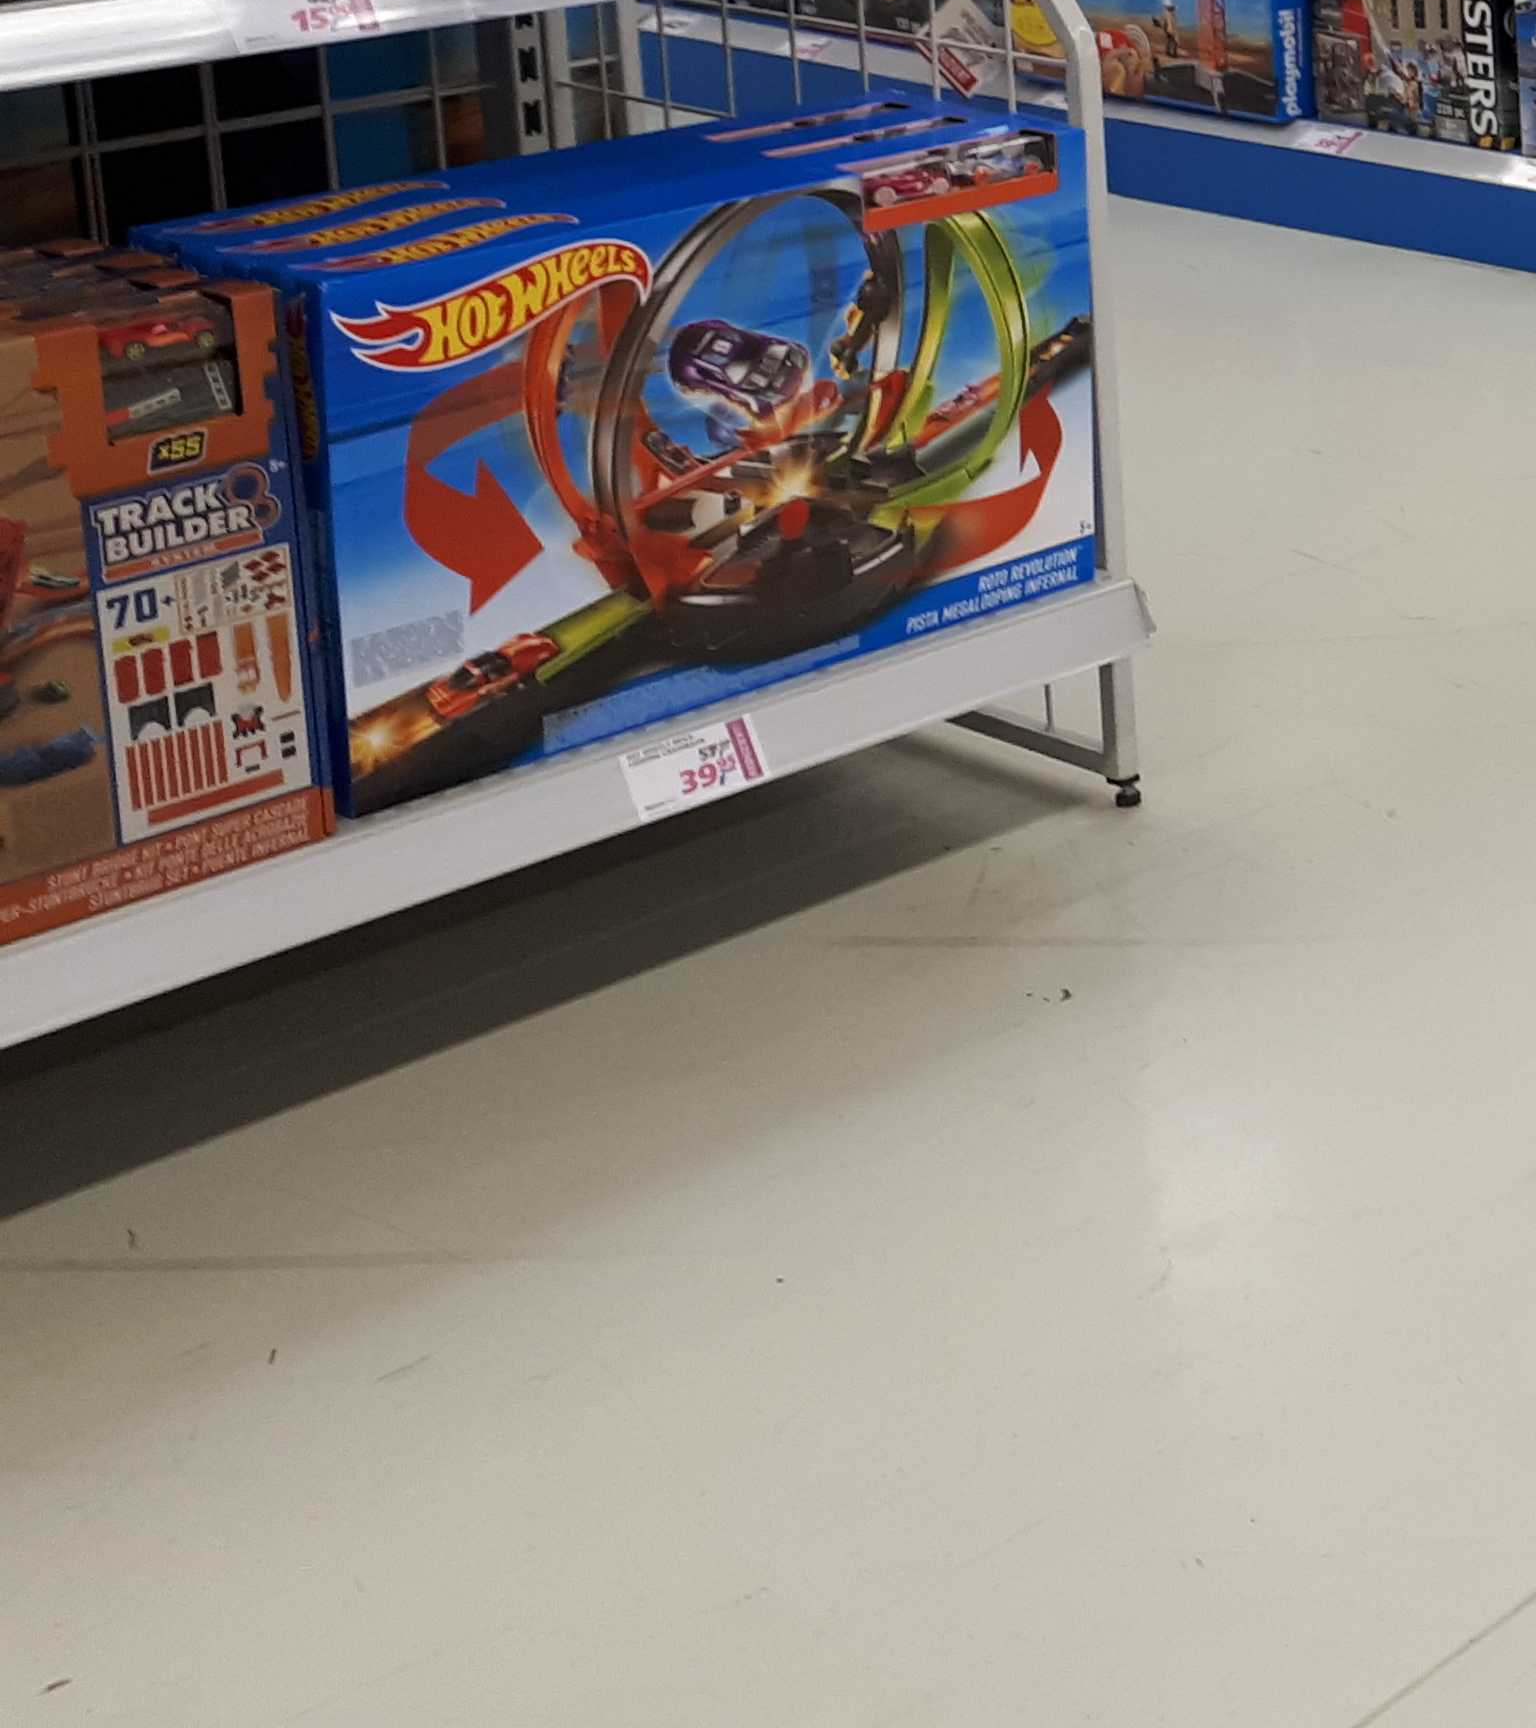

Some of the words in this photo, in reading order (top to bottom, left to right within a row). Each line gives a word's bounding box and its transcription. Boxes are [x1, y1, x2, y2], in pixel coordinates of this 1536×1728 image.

[1277, 8, 1303, 117] playmobil
[415, 282, 512, 363] HOT
[96, 479, 229, 536] TRACK
[103, 504, 254, 566] BUILDER
[905, 612, 940, 635] PISTA
[941, 584, 1024, 628] MEGALOOPING
[1023, 564, 1080, 598] INFERNAL
[977, 568, 1009, 593] ROTO
[1010, 545, 1080, 583] REVOLUTION
